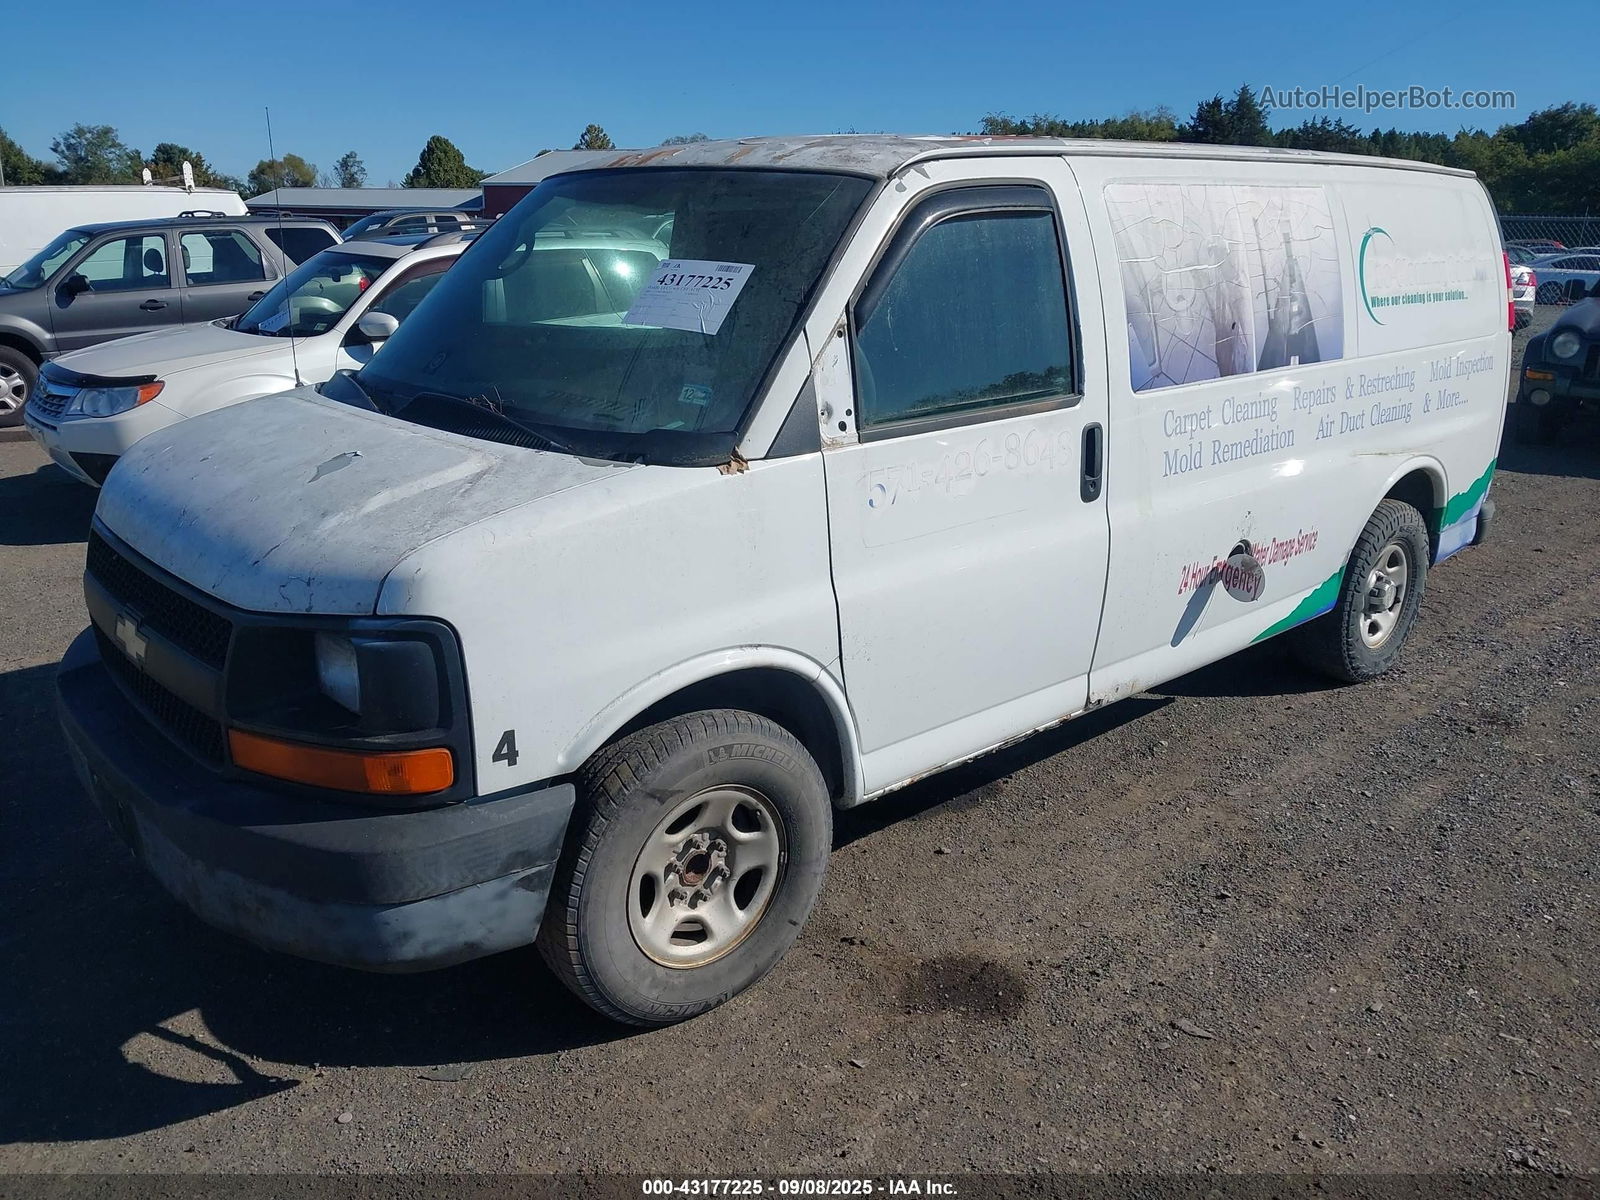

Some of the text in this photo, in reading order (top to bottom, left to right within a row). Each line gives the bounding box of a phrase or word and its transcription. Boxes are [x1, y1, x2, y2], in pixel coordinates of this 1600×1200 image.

[657, 273, 734, 291] 43177225
[1371, 296, 1389, 308] Where
[1391, 296, 1400, 306] our
[1401, 292, 1425, 304] cleaning
[1426, 291, 1432, 303] is
[1433, 292, 1444, 303] your
[683, 388, 695, 400] 12
[1163, 352, 1494, 439] Carpet Cleaning Repairs & Restreching Mold Inspection
[1163, 441, 1203, 477] Mold
[1211, 425, 1295, 465] Remediation
[1315, 411, 1335, 440] Air
[1339, 409, 1366, 435] Duct
[1370, 398, 1413, 427] Cleaning
[1423, 392, 1431, 413] &
[1178, 565, 1191, 595] 24
[1188, 560, 1211, 591] Hour
[1268, 537, 1296, 566] Damage
[1293, 525, 1319, 557] Service
[492, 729, 519, 767] 4
